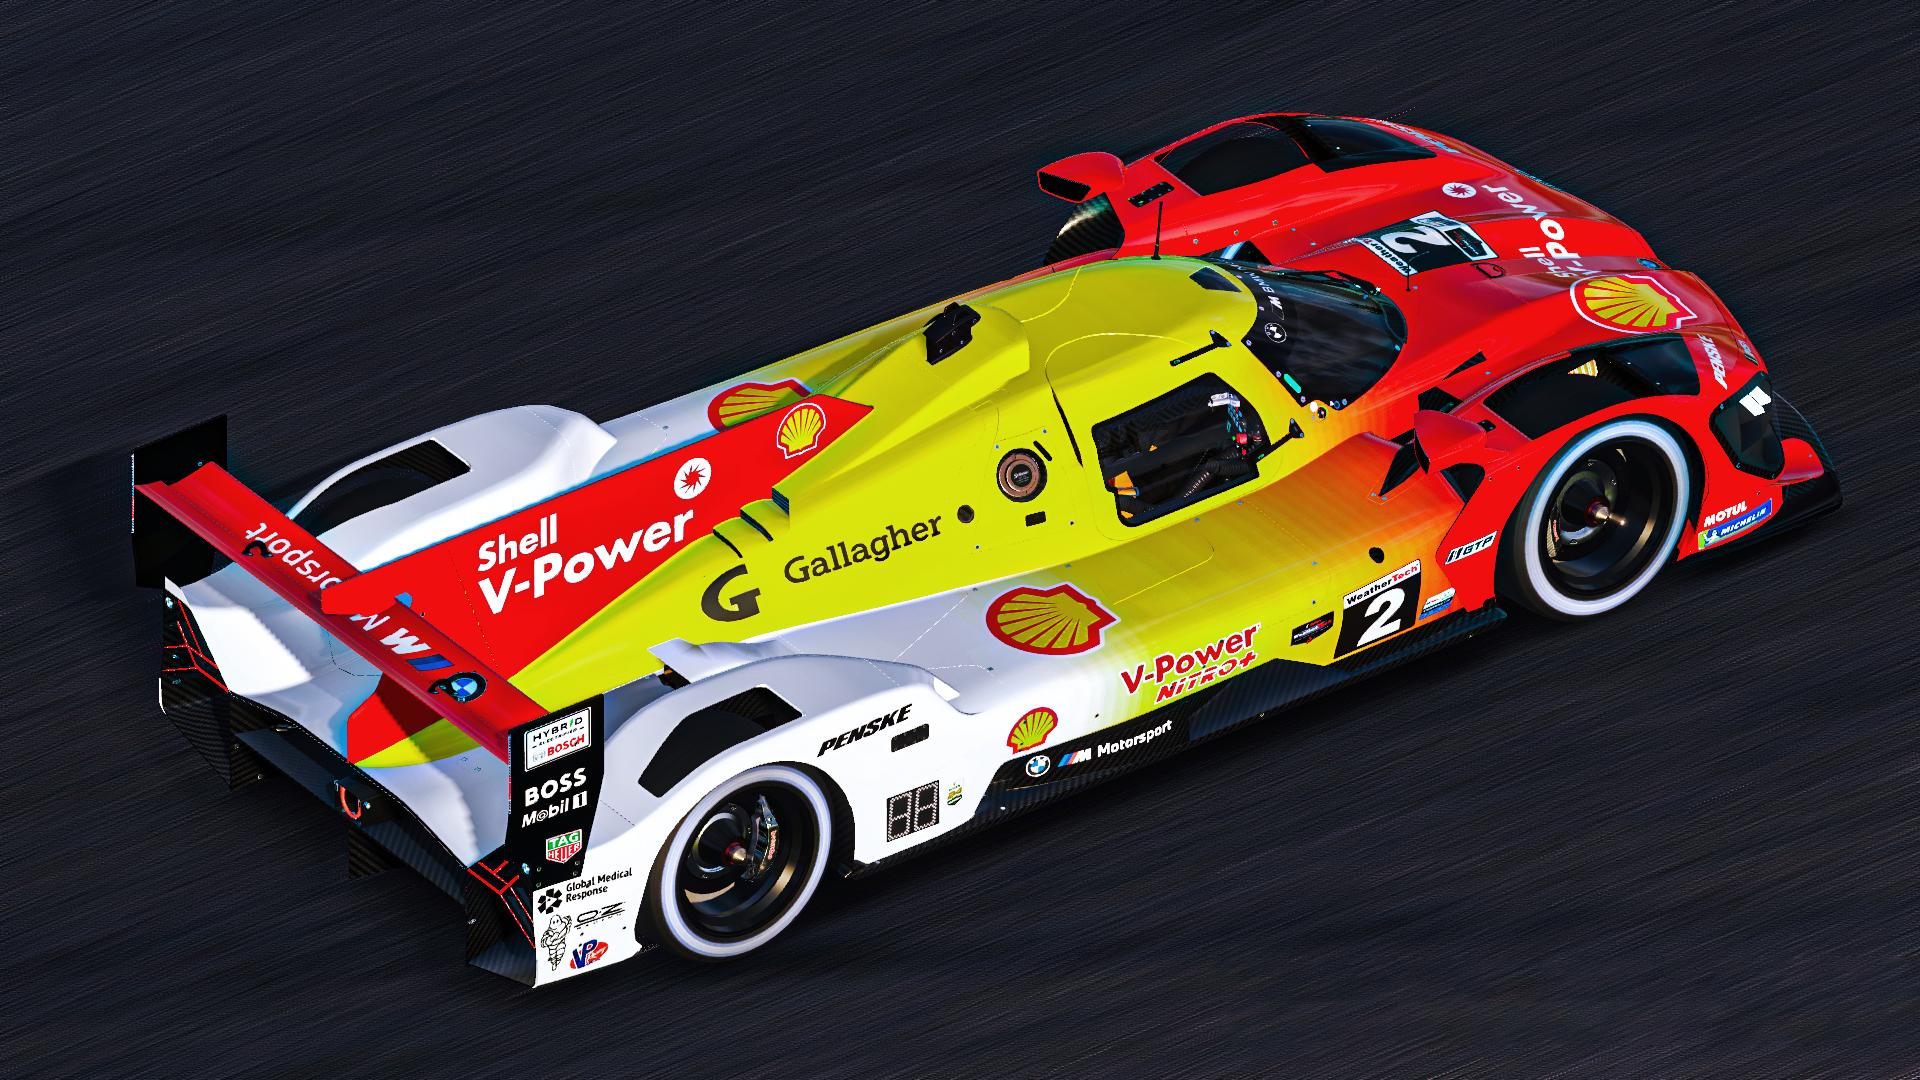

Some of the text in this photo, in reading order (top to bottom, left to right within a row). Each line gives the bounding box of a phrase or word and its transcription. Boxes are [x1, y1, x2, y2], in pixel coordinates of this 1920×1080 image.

[1380, 225, 1452, 254] 2
[1704, 501, 1747, 528] MOTUL
[1721, 507, 1767, 536] MICHELIN
[477, 512, 558, 572] Shell
[783, 515, 942, 583] Gallagher
[478, 509, 694, 615] V-Power
[701, 563, 761, 622] G
[1346, 564, 1418, 605] WeatherTech
[1356, 587, 1406, 648] 2
[1120, 625, 1258, 695] V-Power
[547, 734, 585, 757] BOSCH
[817, 703, 913, 758] PENSKE
[1097, 719, 1173, 757] Motorsport
[525, 767, 587, 807] BOSS
[573, 791, 588, 809] 1
[548, 831, 580, 848] TAG
[548, 843, 580, 861] HEUER
[565, 885, 609, 903] Response
[566, 867, 633, 892] Global Medical
[572, 939, 598, 969] VP
